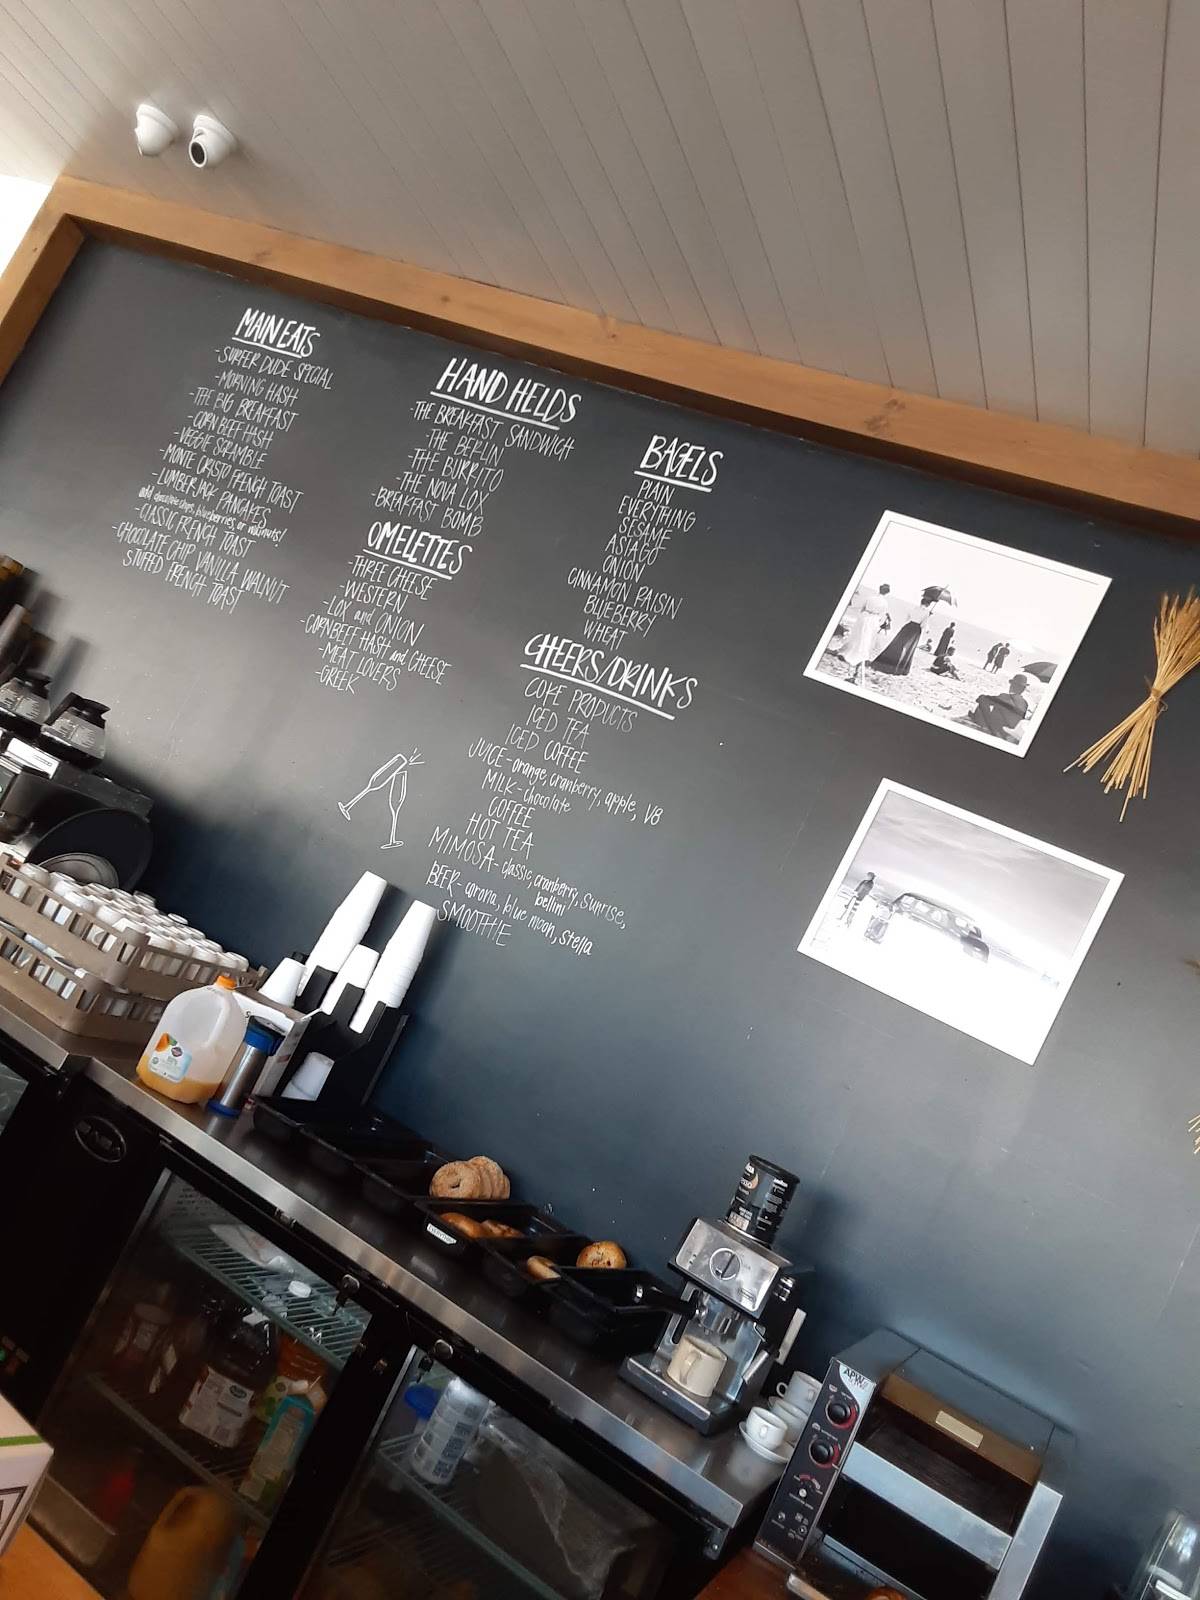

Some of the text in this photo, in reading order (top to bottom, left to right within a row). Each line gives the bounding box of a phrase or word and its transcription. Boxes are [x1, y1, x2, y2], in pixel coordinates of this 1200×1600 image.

[235, 308, 320, 357] MAIN EATS
[259, 355, 294, 378] DUDE
[294, 362, 334, 390] SPECIAL
[436, 358, 582, 423] HAND HELDS
[213, 393, 235, 413] BIG
[235, 398, 299, 432] BREAKFAST
[265, 384, 299, 407] HASH
[217, 418, 242, 438] BEEF
[242, 423, 273, 450] HASH
[435, 404, 504, 440] BREAKFAST
[505, 424, 575, 462] SANDWICH
[454, 435, 504, 467] BERLIN
[213, 437, 268, 470] SCRAMBLE
[640, 435, 723, 486] BAGELS
[197, 455, 231, 482] CRISTO
[227, 469, 268, 499] FRENCH
[267, 481, 304, 514] TOAST
[442, 456, 504, 492] BURRITO
[637, 480, 675, 505] PLAIN
[216, 491, 271, 529] PANCAKES
[426, 478, 458, 505] NOVA
[459, 488, 489, 515] LOX
[618, 495, 696, 532] EVERYTHING
[175, 515, 218, 546] FRENCH
[219, 531, 256, 558] TOAST
[441, 507, 484, 537] BOMB
[619, 517, 673, 550] SESAME
[368, 521, 472, 574] OMELETTES
[605, 533, 658, 565] ASIAGO
[123, 549, 246, 614] STUFFED FRENCH TOAST
[166, 539, 196, 561] CHIP
[196, 551, 239, 585] VANILLA
[241, 568, 290, 604] WALNUT
[387, 565, 437, 600] CHEESE
[603, 555, 646, 582] ONION
[568, 568, 683, 619] CINNAMON RAISIN
[354, 609, 375, 625] and
[375, 613, 424, 647] ONION
[584, 594, 657, 638] BLUEBERRY
[584, 619, 628, 650] WHEAT
[357, 657, 400, 691] LOVERS
[359, 631, 391, 659] HASH
[389, 649, 408, 665] and
[408, 650, 452, 685] CHEESE
[525, 677, 637, 733] COKE PRODUCTS
[526, 704, 590, 749] ICED TEA
[505, 724, 589, 774] ICED COFFEE
[488, 796, 536, 829] COFFEE
[550, 773, 601, 811] cranberry,
[605, 792, 636, 821] apple,
[644, 804, 663, 826] V8
[465, 812, 534, 860] HOT TEA
[534, 873, 579, 910] cranberry,
[534, 892, 566, 917] bellini
[436, 900, 512, 947] SMOOTHIE
[465, 882, 500, 911] corona,
[503, 894, 527, 921] blue
[528, 915, 557, 945] moon,
